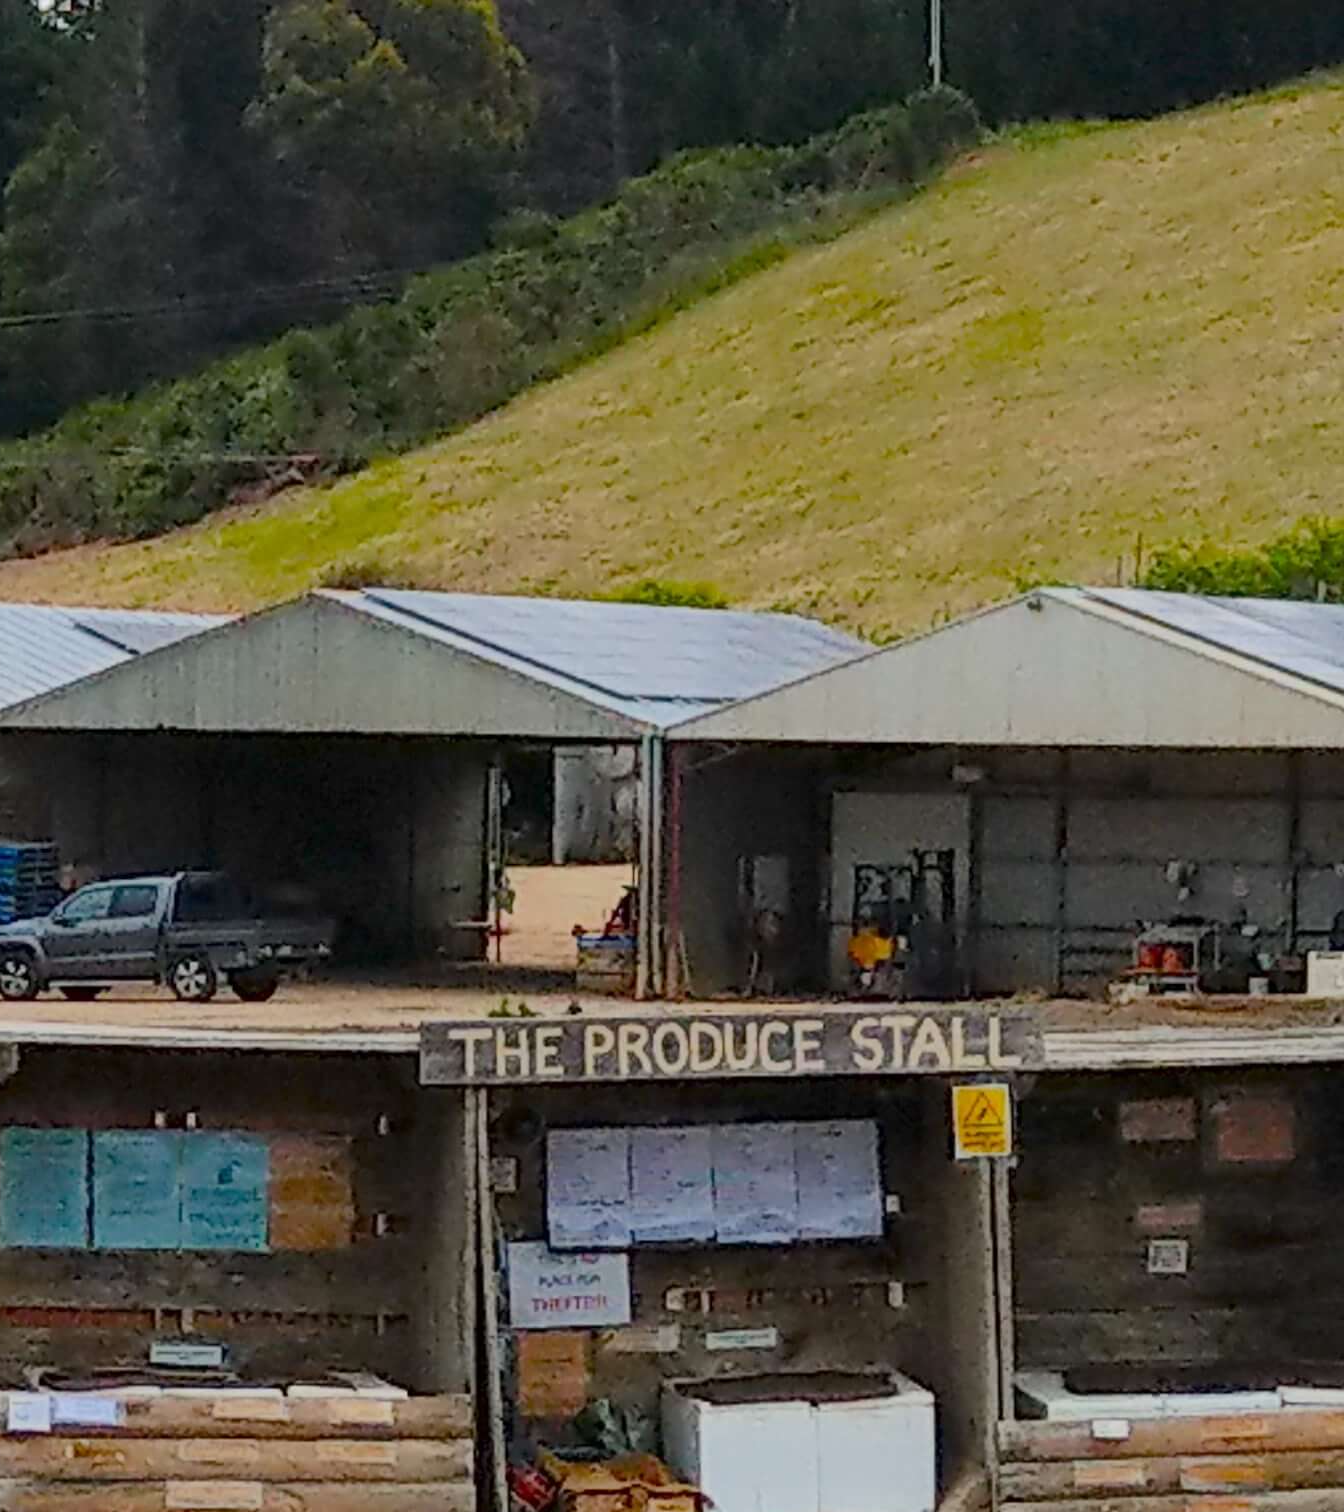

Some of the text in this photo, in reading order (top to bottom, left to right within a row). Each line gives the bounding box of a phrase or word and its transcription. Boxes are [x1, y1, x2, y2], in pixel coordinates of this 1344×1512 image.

[449, 1014, 1021, 1078] THE PRODUCE STALL
